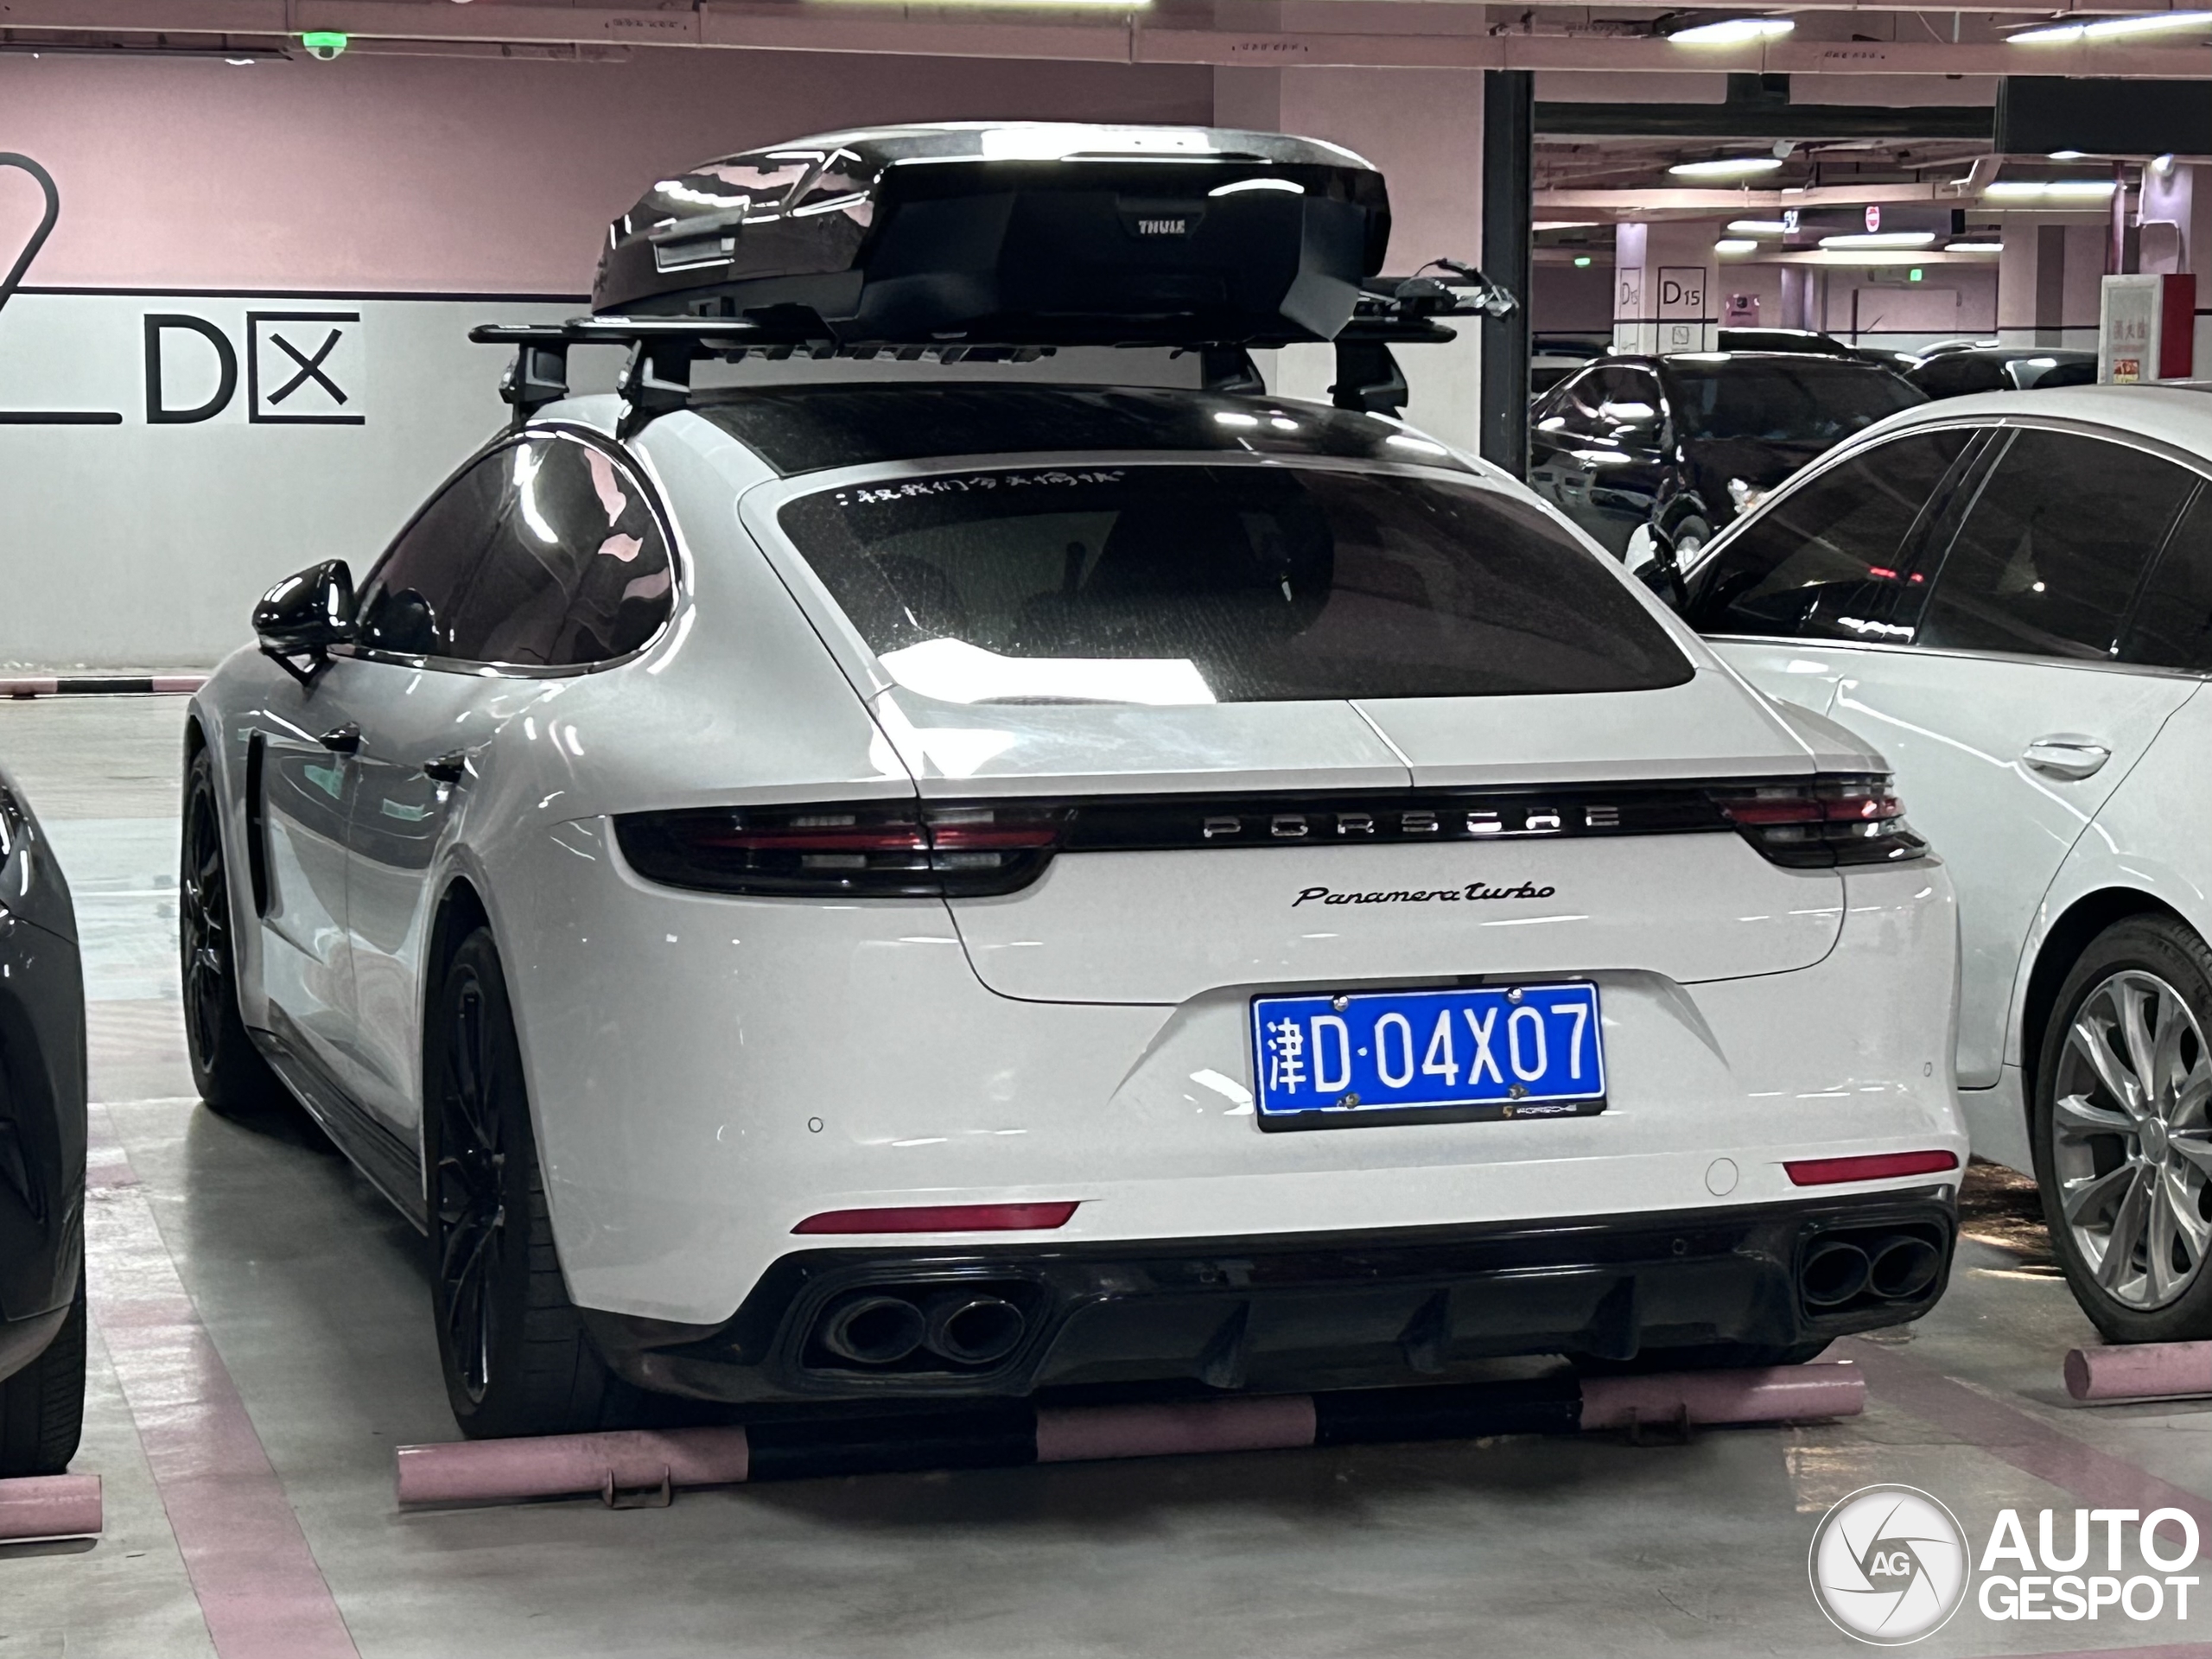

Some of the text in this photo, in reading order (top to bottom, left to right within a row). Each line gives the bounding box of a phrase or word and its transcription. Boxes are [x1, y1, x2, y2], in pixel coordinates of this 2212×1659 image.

[1138, 219, 1185, 234] THULE
[1663, 281, 1700, 306] D15
[1204, 804, 1620, 838] PORSCHE
[1292, 887, 1460, 907] Panamera
